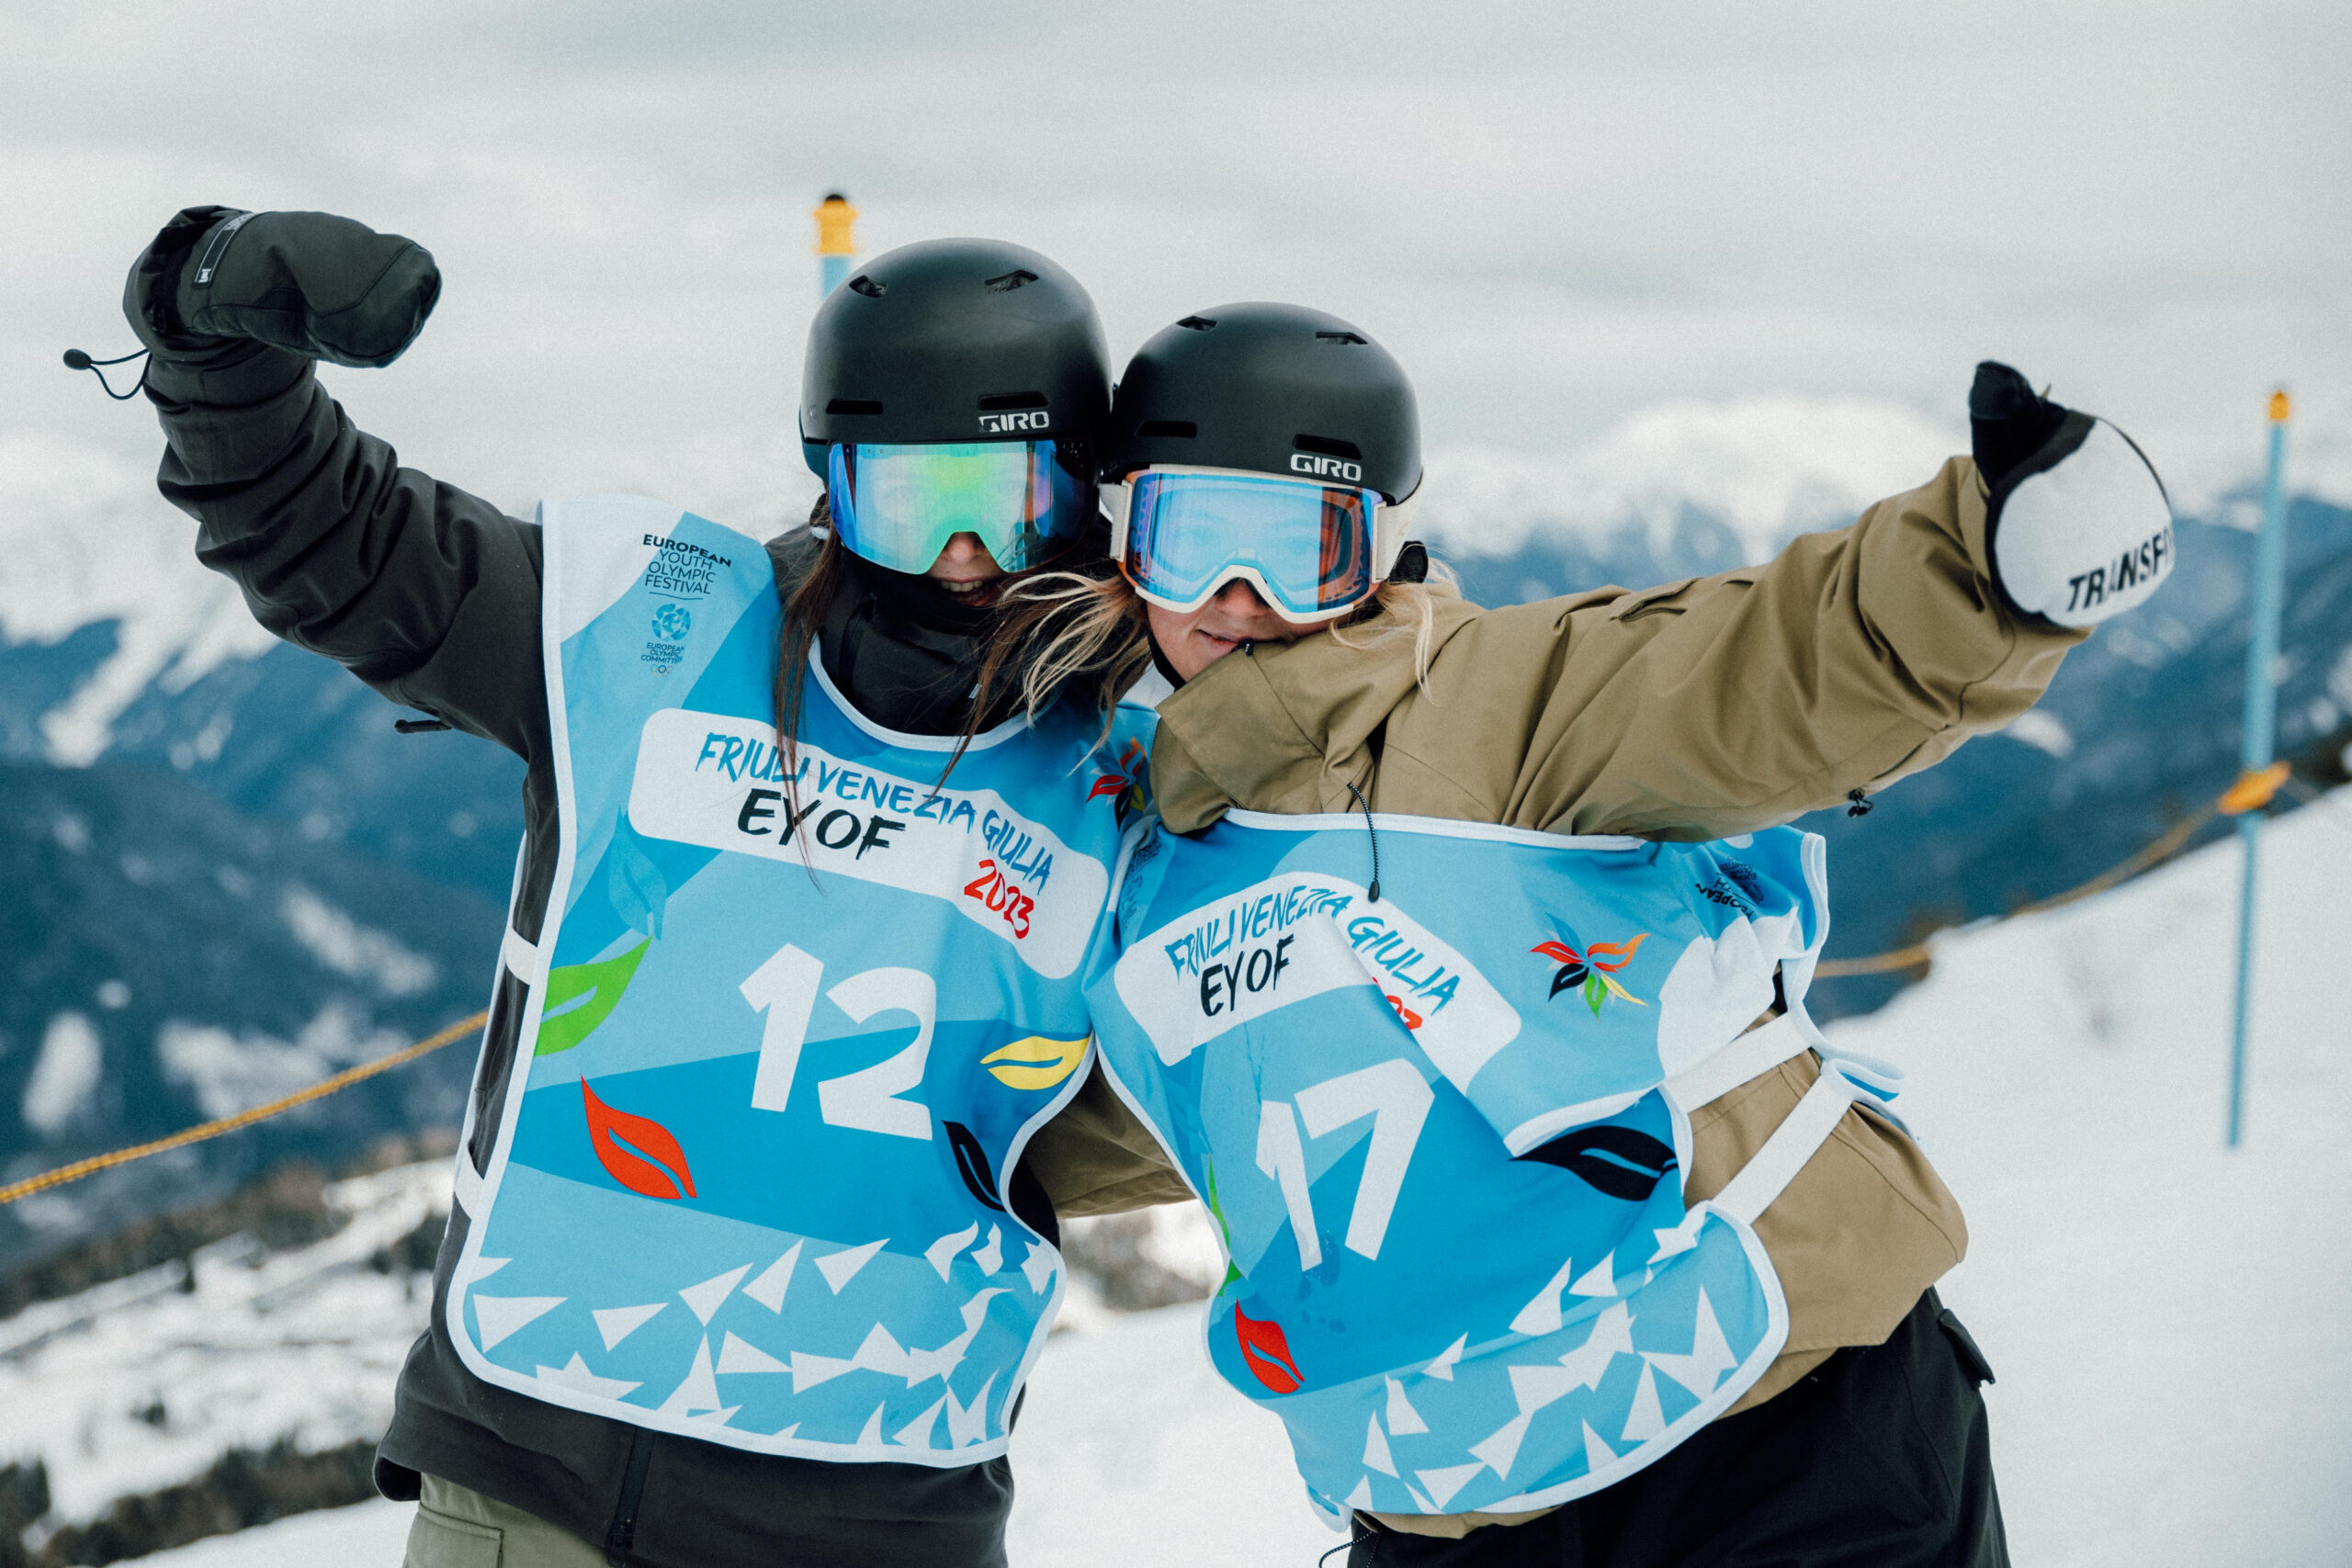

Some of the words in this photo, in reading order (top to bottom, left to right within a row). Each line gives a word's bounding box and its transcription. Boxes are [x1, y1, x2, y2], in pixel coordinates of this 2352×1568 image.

[1291, 454, 1362, 481] GIRO
[643, 534, 731, 567] EUROPEAN
[645, 574, 710, 594] FESTIVAL
[649, 561, 716, 582] OLYMPIC
[660, 549, 713, 570] YOUTH
[647, 642, 684, 652] EUROPEAN
[695, 732, 809, 783] FRIULI
[818, 759, 977, 833] VENEZIA
[982, 808, 1054, 896] GIULIA
[738, 788, 905, 860] EYOF
[964, 859, 1035, 939] 2023
[1200, 933, 1295, 1017] EYOF
[1347, 916, 1461, 1017] GIULIA
[739, 942, 936, 1141] 12
[1255, 1057, 1435, 1272] 17
